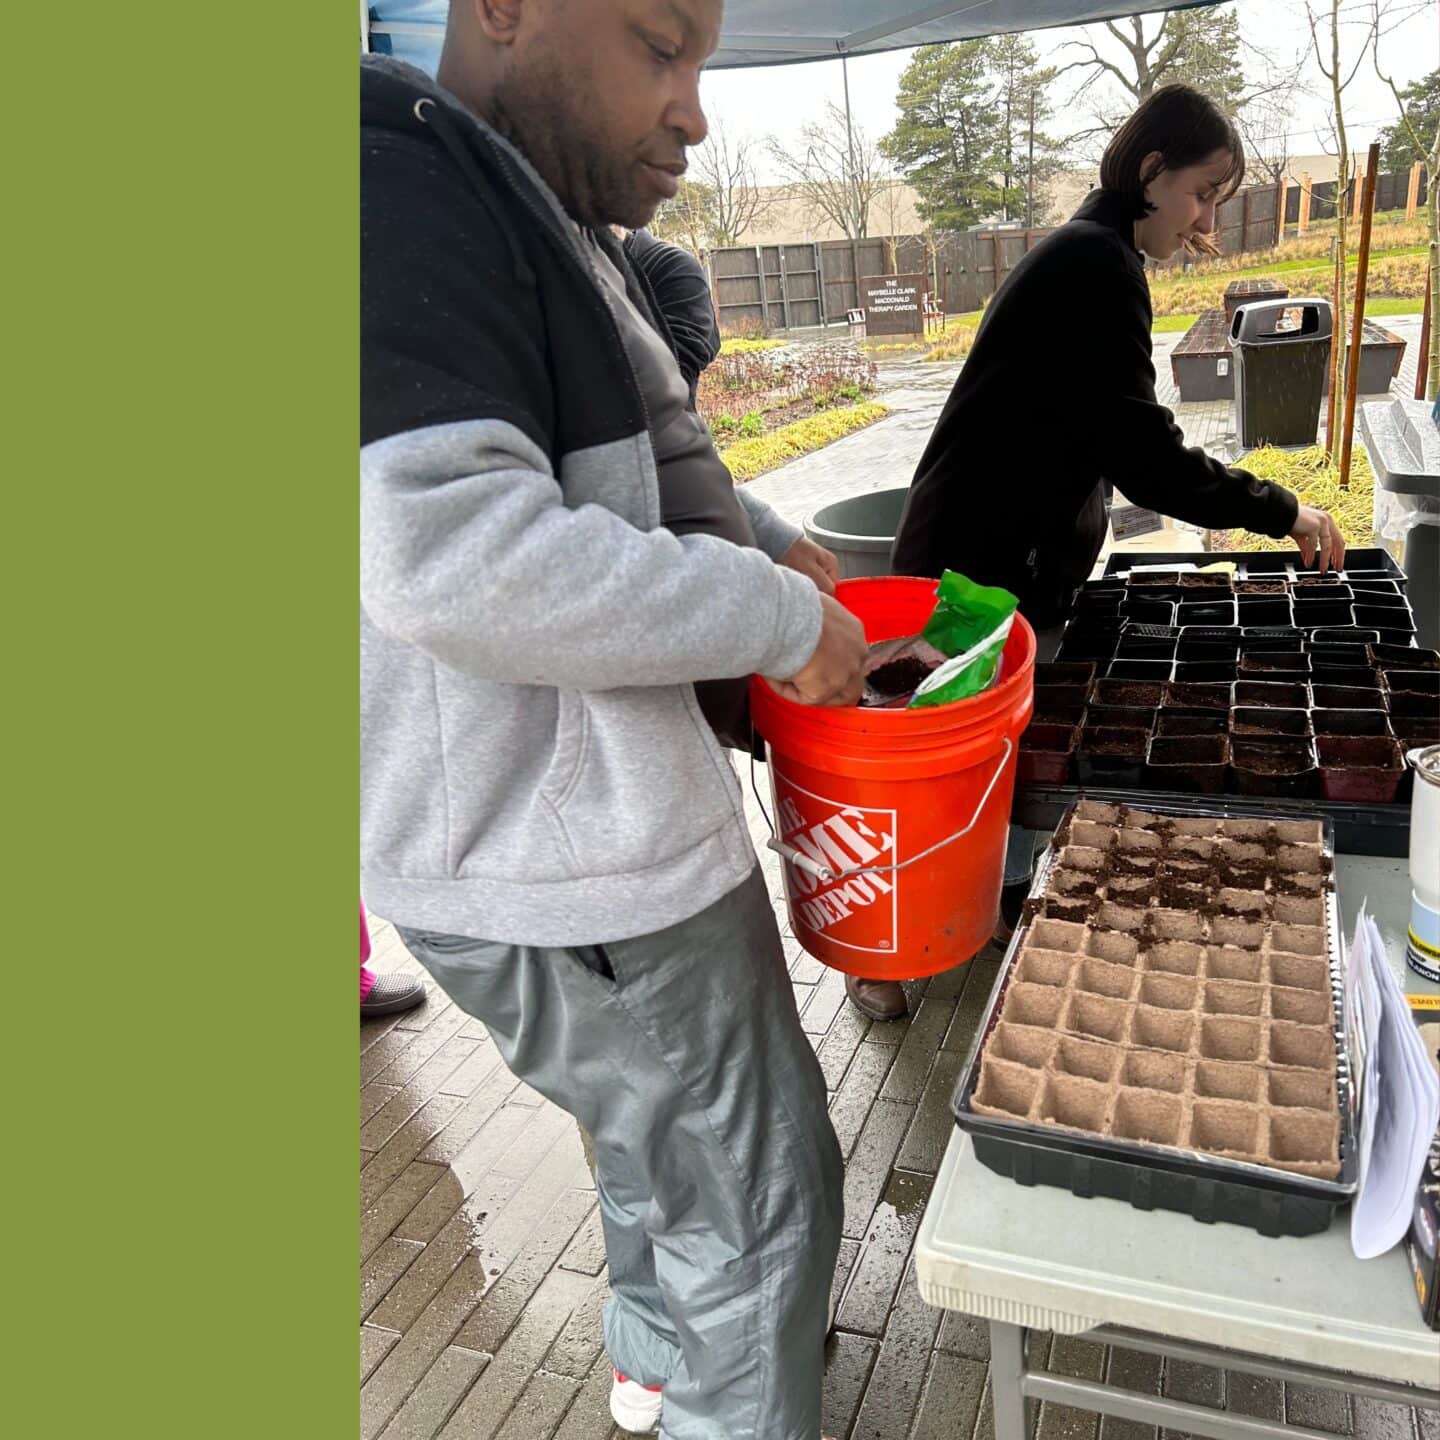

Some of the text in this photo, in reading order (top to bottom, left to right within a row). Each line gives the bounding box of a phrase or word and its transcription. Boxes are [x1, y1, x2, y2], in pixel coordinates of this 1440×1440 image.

[779, 797, 807, 832] HE
[788, 808, 893, 898] OME
[801, 866, 893, 930] DEPOT
